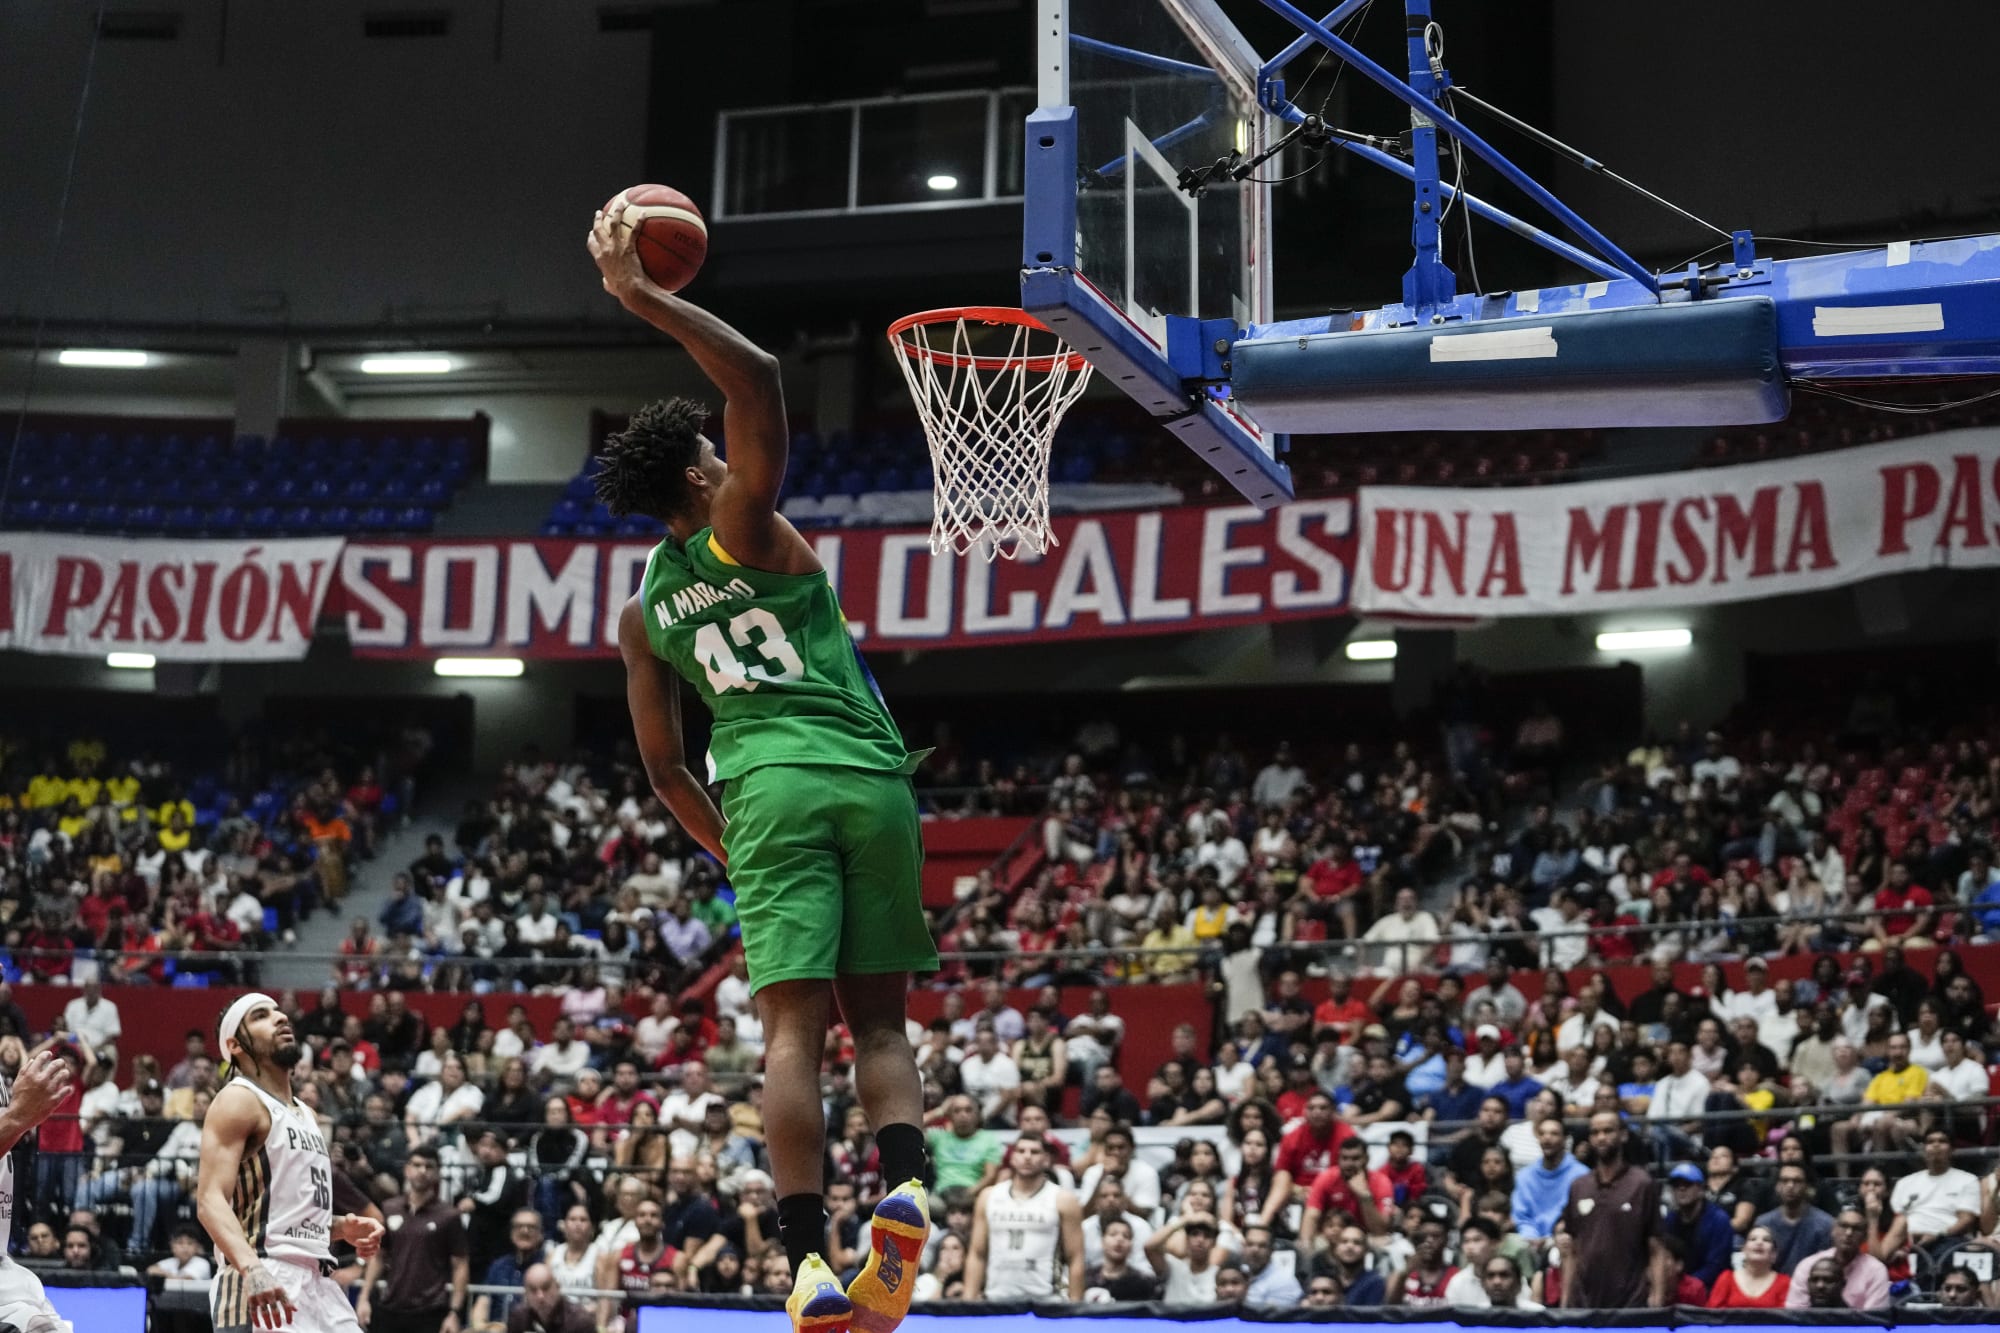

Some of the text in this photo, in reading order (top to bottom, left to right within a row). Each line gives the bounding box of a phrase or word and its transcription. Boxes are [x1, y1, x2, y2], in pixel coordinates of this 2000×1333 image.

[1373, 453, 2000, 597] UNA MISMA PA
[42, 546, 325, 643] PASIÓN
[339, 543, 649, 646] SOM
[694, 608, 804, 695] 43
